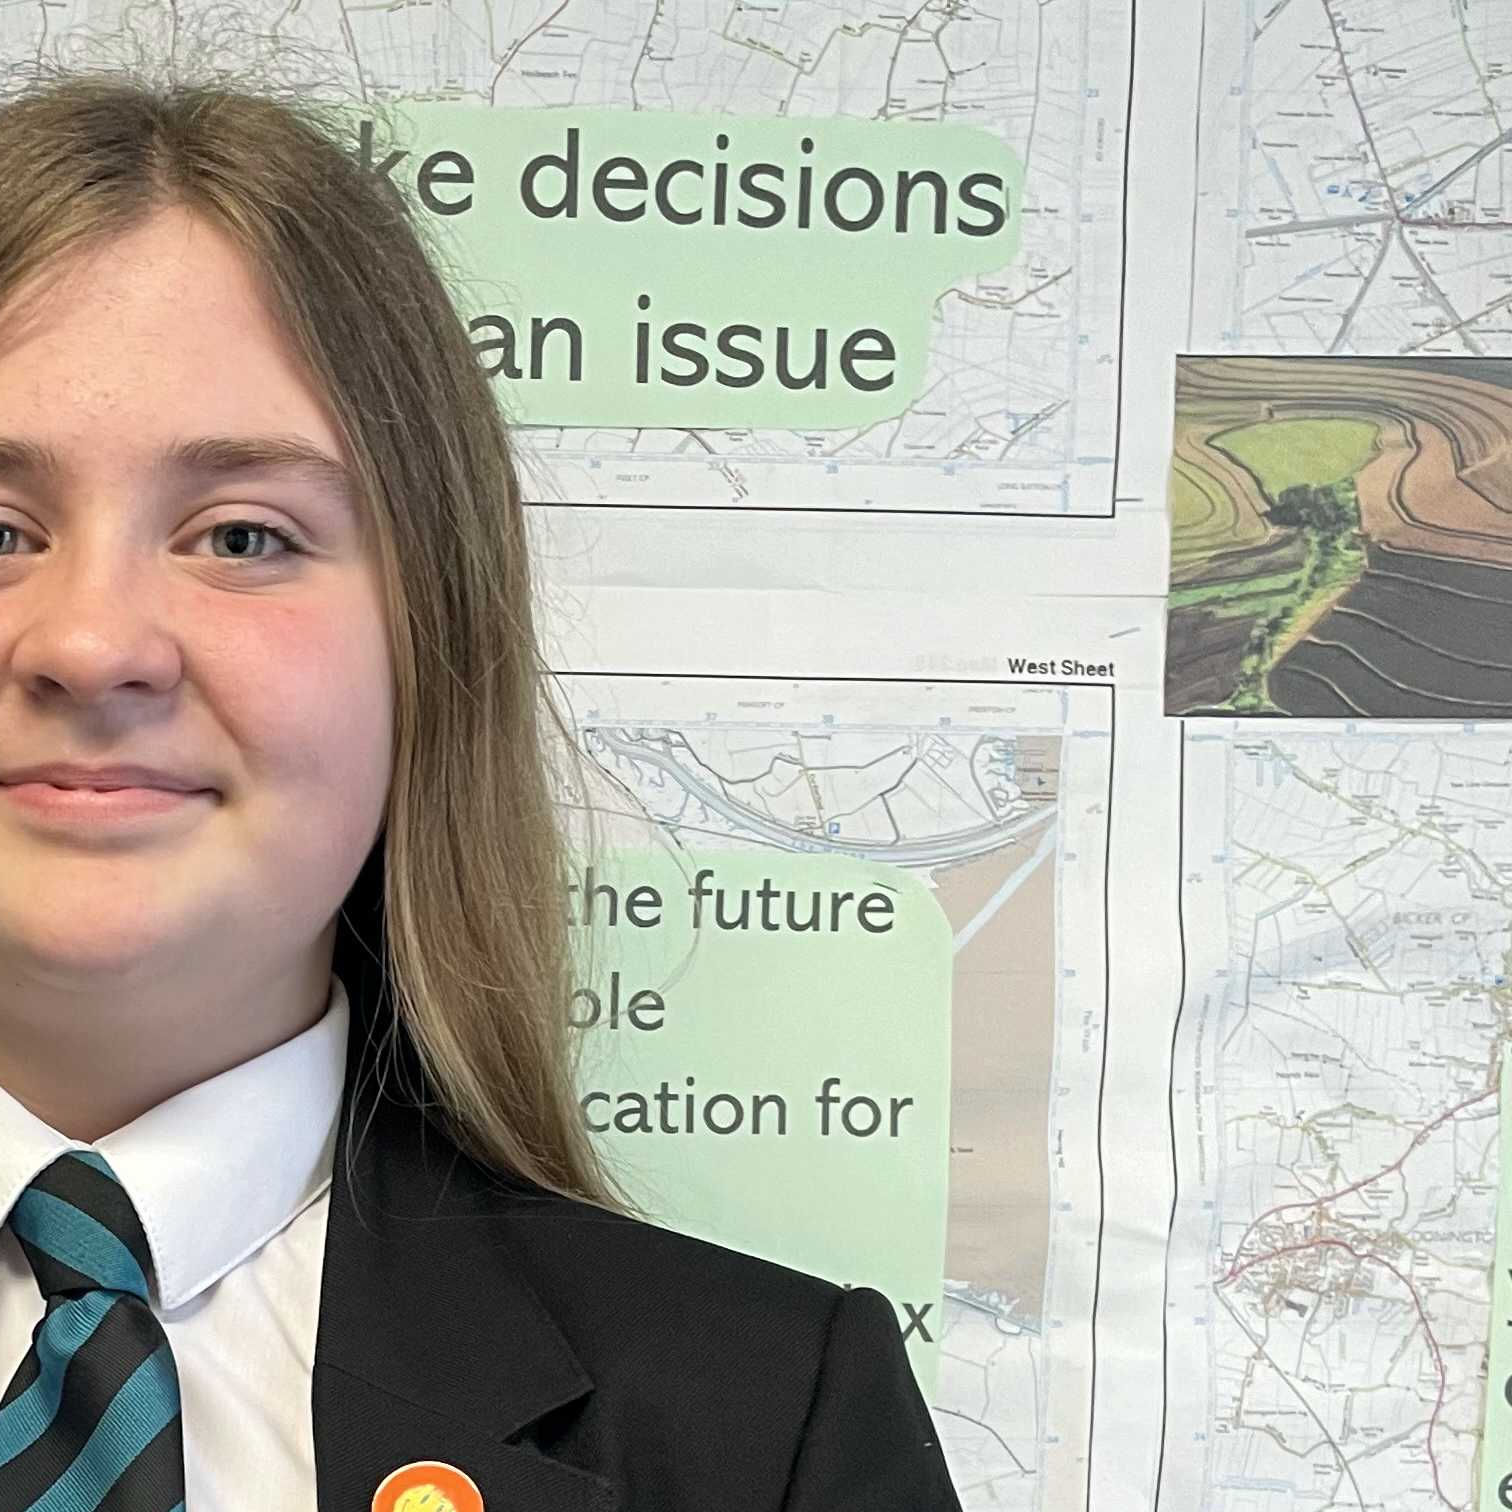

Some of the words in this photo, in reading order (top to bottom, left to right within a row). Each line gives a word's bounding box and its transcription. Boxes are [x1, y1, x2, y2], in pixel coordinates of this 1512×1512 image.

[520, 128, 1005, 237] decisions
[468, 314, 583, 381] an
[635, 294, 897, 392] issue
[1007, 658, 1056, 675] West
[1061, 660, 1114, 677] Sheet
[688, 869, 895, 934] future
[580, 1077, 787, 1135] cation
[815, 1078, 913, 1138] for
